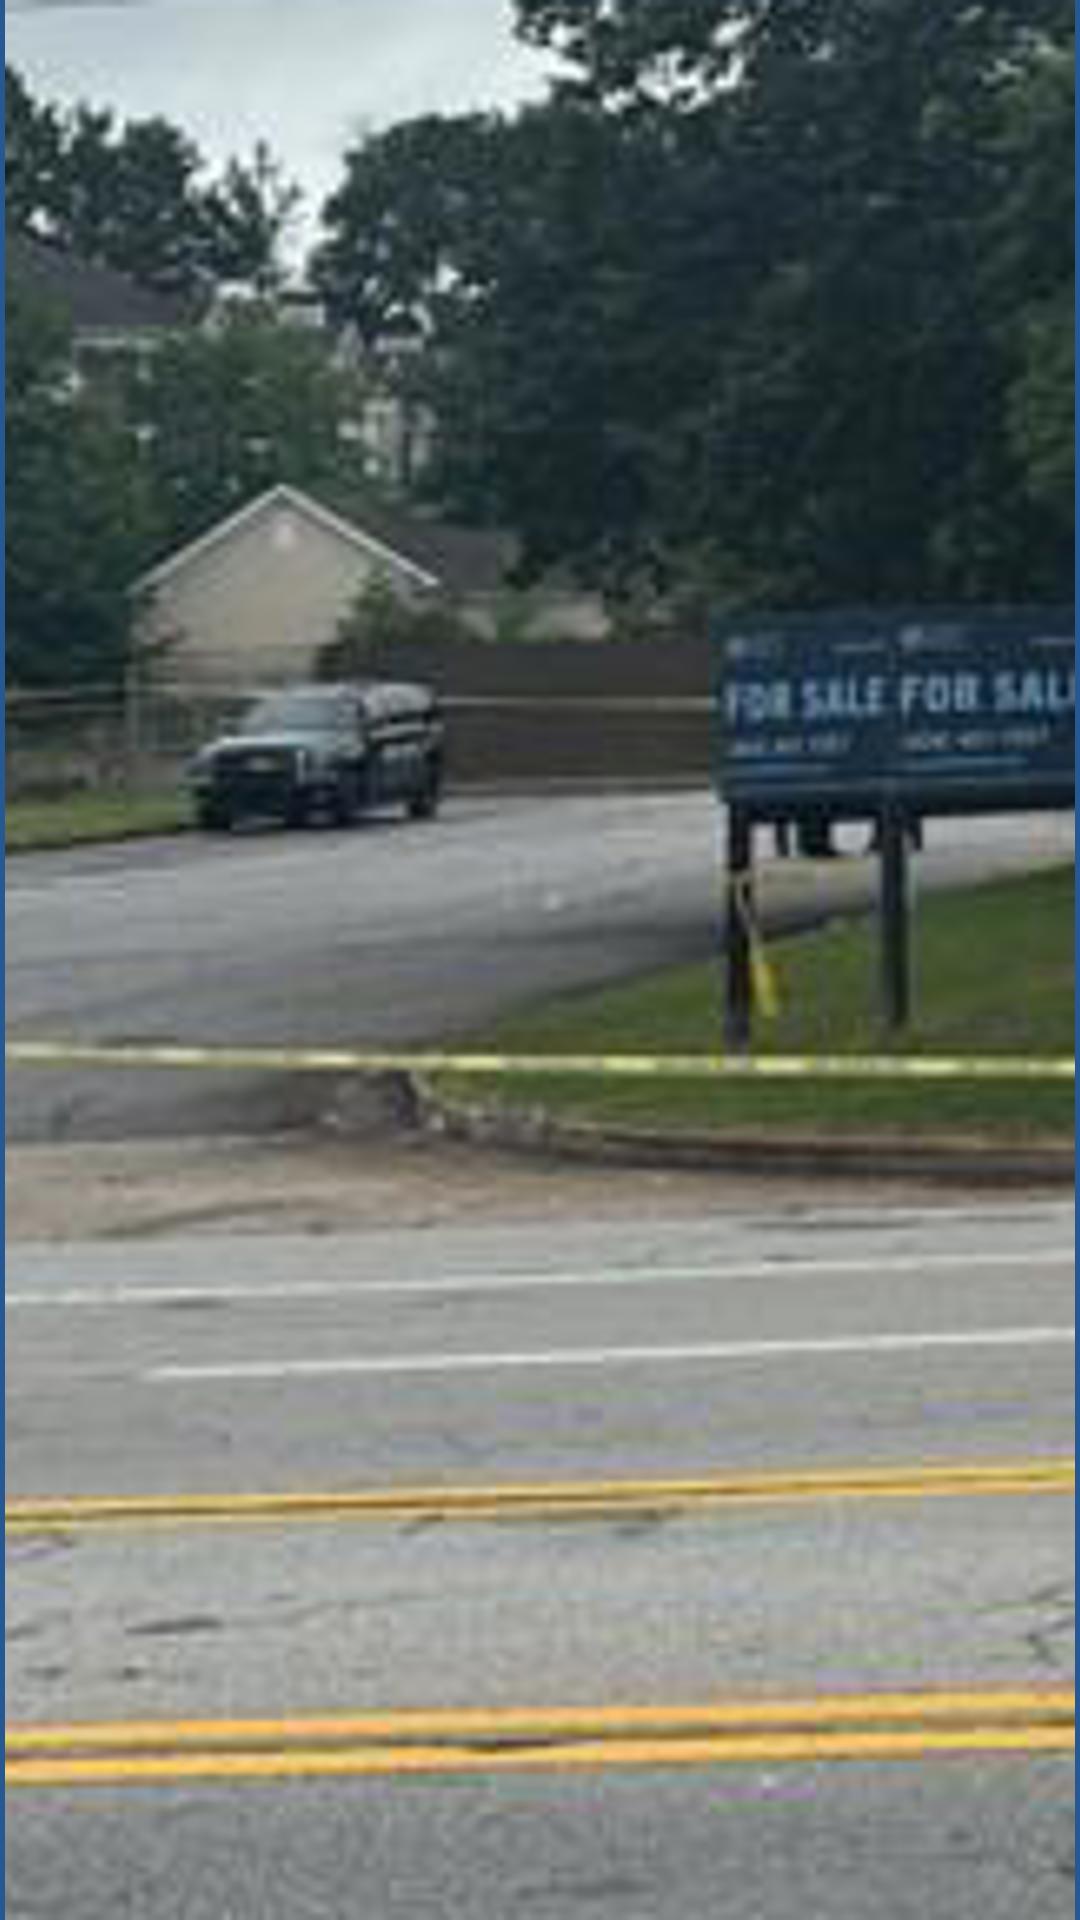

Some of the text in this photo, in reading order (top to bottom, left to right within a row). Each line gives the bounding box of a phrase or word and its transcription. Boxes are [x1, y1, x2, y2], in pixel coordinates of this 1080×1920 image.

[726, 676, 884, 721] FOR SALE
[901, 675, 977, 717] FOR
